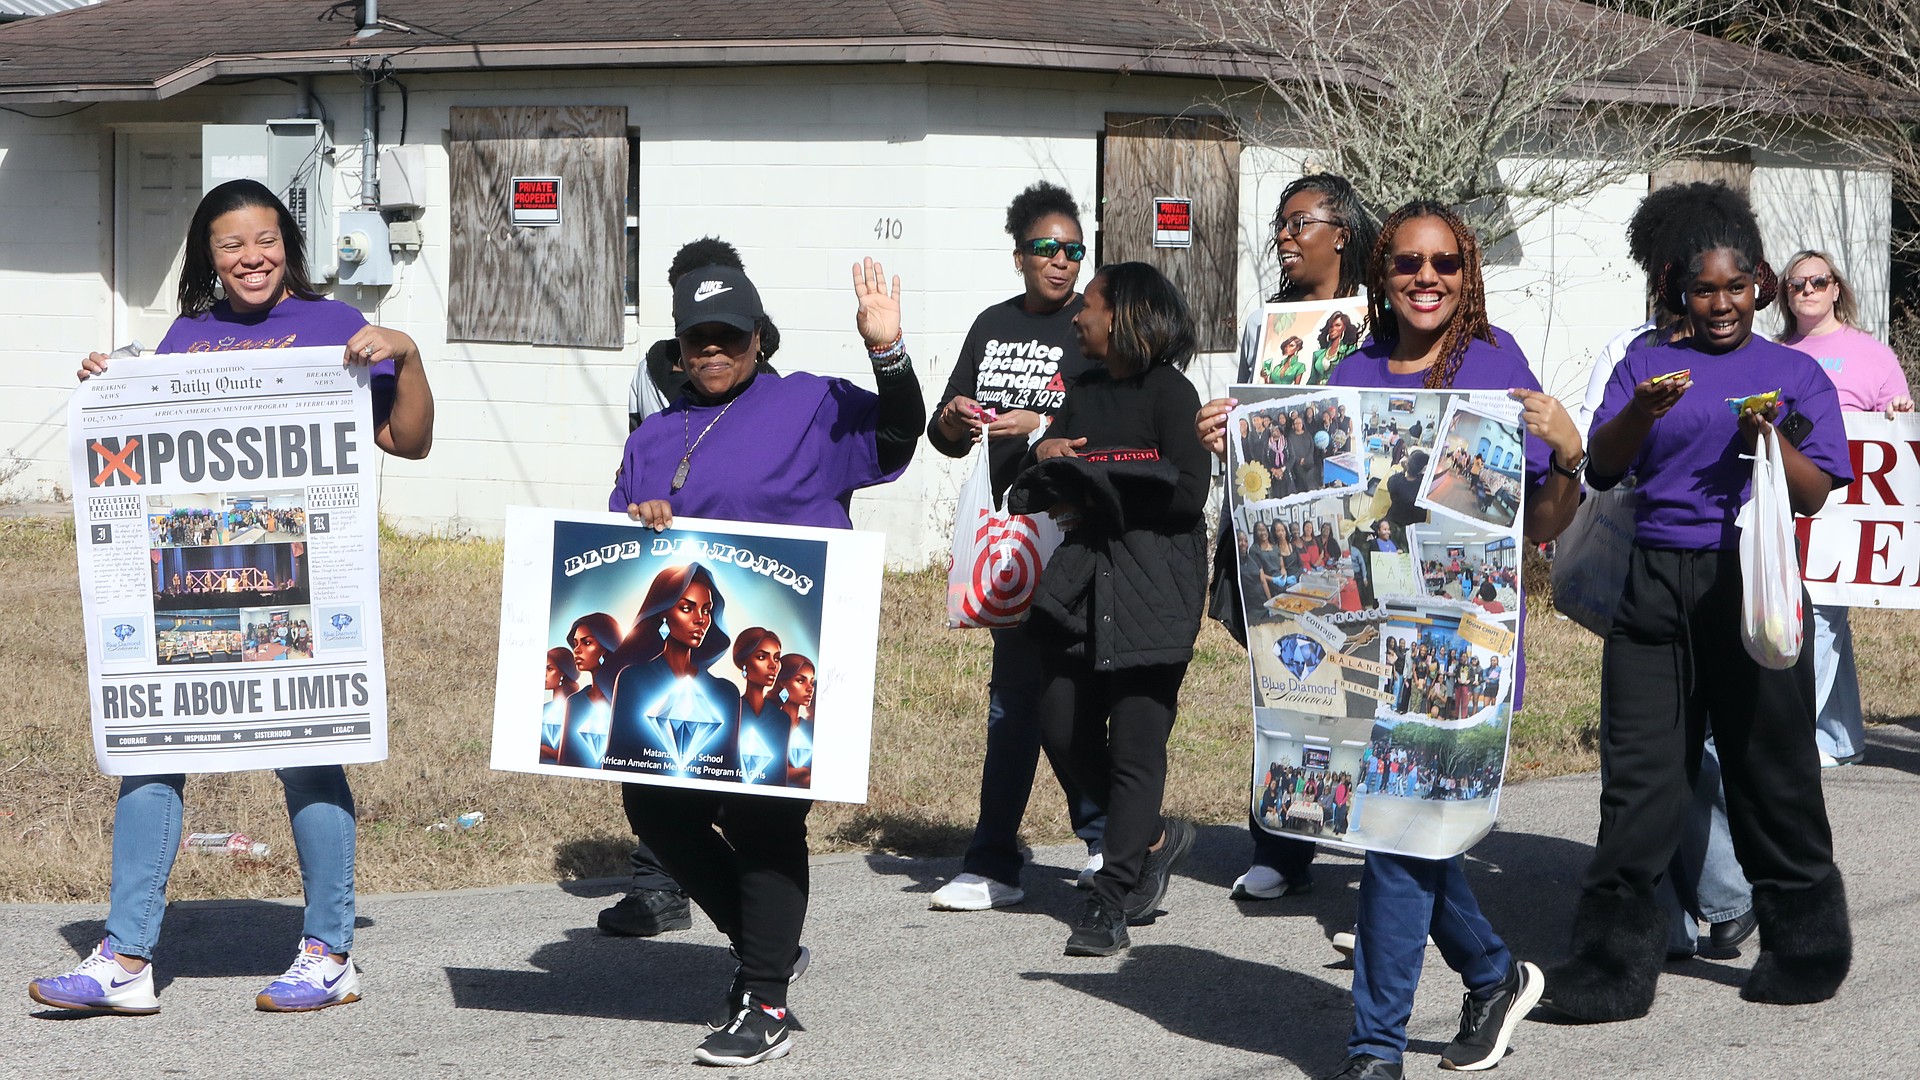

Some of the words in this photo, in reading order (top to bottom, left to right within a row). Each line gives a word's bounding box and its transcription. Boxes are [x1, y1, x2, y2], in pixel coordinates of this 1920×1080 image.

[518, 182, 552, 192] PRIVATE
[514, 193, 556, 203] PROPERTY
[1161, 203, 1188, 214] PRIVATE
[1157, 214, 1190, 225] PROPERTY
[874, 217, 903, 240] 410
[700, 280, 724, 294] NIKE
[984, 339, 1064, 361] Service
[978, 356, 1058, 375] Became
[306, 370, 341, 378] BREAKING
[91, 384, 127, 392] BREAKING
[170, 378, 210, 396] Daily
[215, 376, 263, 394] Quote
[100, 392, 120, 400] NEWS
[1031, 390, 1066, 408] 1913
[153, 410, 183, 418] AFRICAN
[184, 408, 221, 416] AMERICAN
[222, 404, 252, 412] MENTOR
[253, 402, 288, 410] PROGRAM
[303, 400, 340, 408] FEBRUARY
[308, 492, 358, 500] EXCELLENCE
[311, 484, 355, 494] EXCLUSIVE
[90, 502, 140, 512] EXCELLENCE
[92, 496, 137, 506] EXCLUSIVE
[312, 499, 356, 508] EXCLUSIVE
[94, 510, 138, 518] EXCLUSIVE
[564, 540, 641, 577] BLUE
[1794, 517, 1920, 588] LE
[1324, 608, 1387, 623] TRAVEL
[1305, 616, 1337, 641] courage
[1329, 654, 1390, 677] BALANCE
[1261, 675, 1286, 691] Blue
[1288, 677, 1337, 696] Diamond
[1334, 679, 1396, 702] FRIENDSHIP
[102, 683, 164, 719] RISE
[174, 678, 263, 716] ABOVE
[272, 672, 369, 712] LIMITS
[118, 736, 148, 746] COURAGE
[184, 734, 222, 743] INSPIRATION
[254, 730, 292, 740] SISTERHOOD
[332, 725, 354, 734] LEGACY
[643, 748, 677, 758] Matanza
[680, 750, 697, 761] Hh
[698, 753, 724, 764] School
[600, 756, 626, 766] African
[627, 758, 662, 770] American
[663, 761, 702, 774] Menoring
[703, 766, 734, 778] Program
[749, 770, 766, 779] Grls
